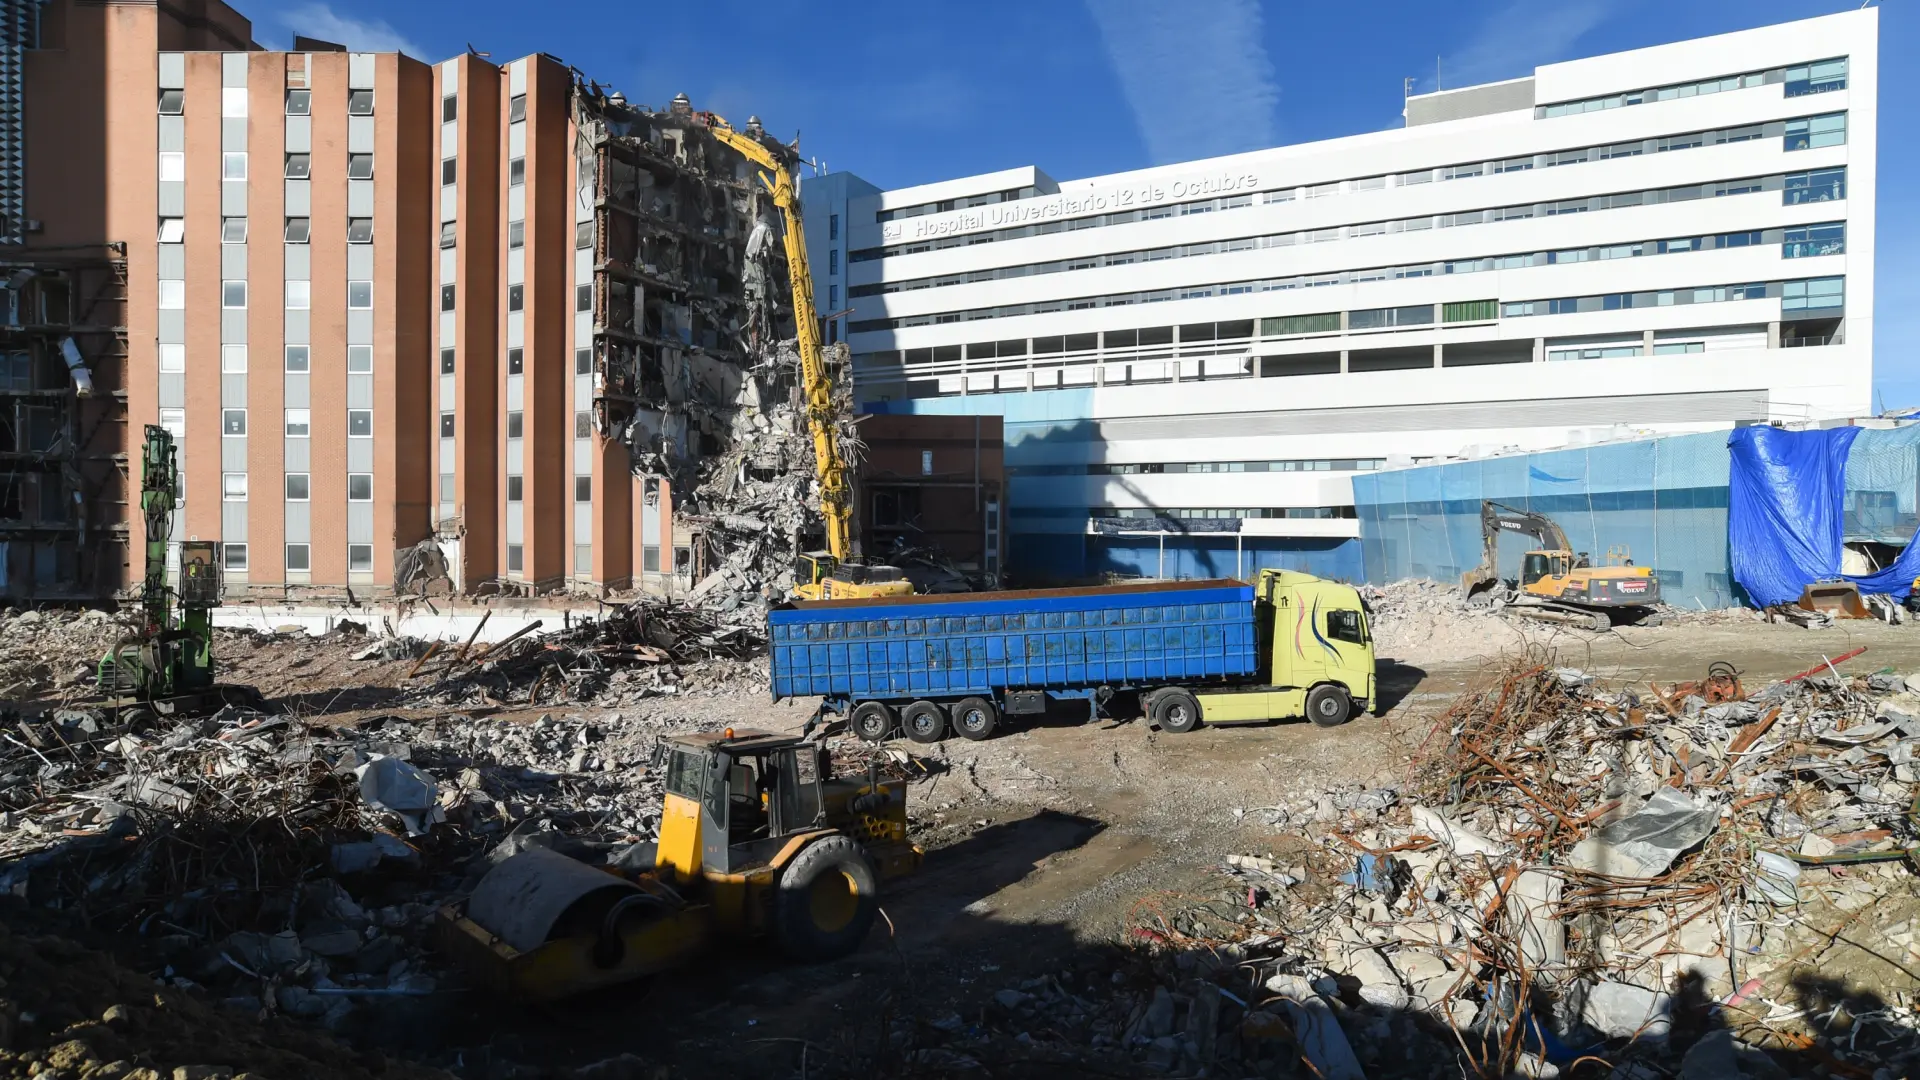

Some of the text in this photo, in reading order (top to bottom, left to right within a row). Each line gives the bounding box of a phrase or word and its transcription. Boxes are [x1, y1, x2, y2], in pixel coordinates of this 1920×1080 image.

[915, 171, 1259, 237] Hospital Universitario 12 de Octubre
[1500, 520, 1521, 529] VOLVO
